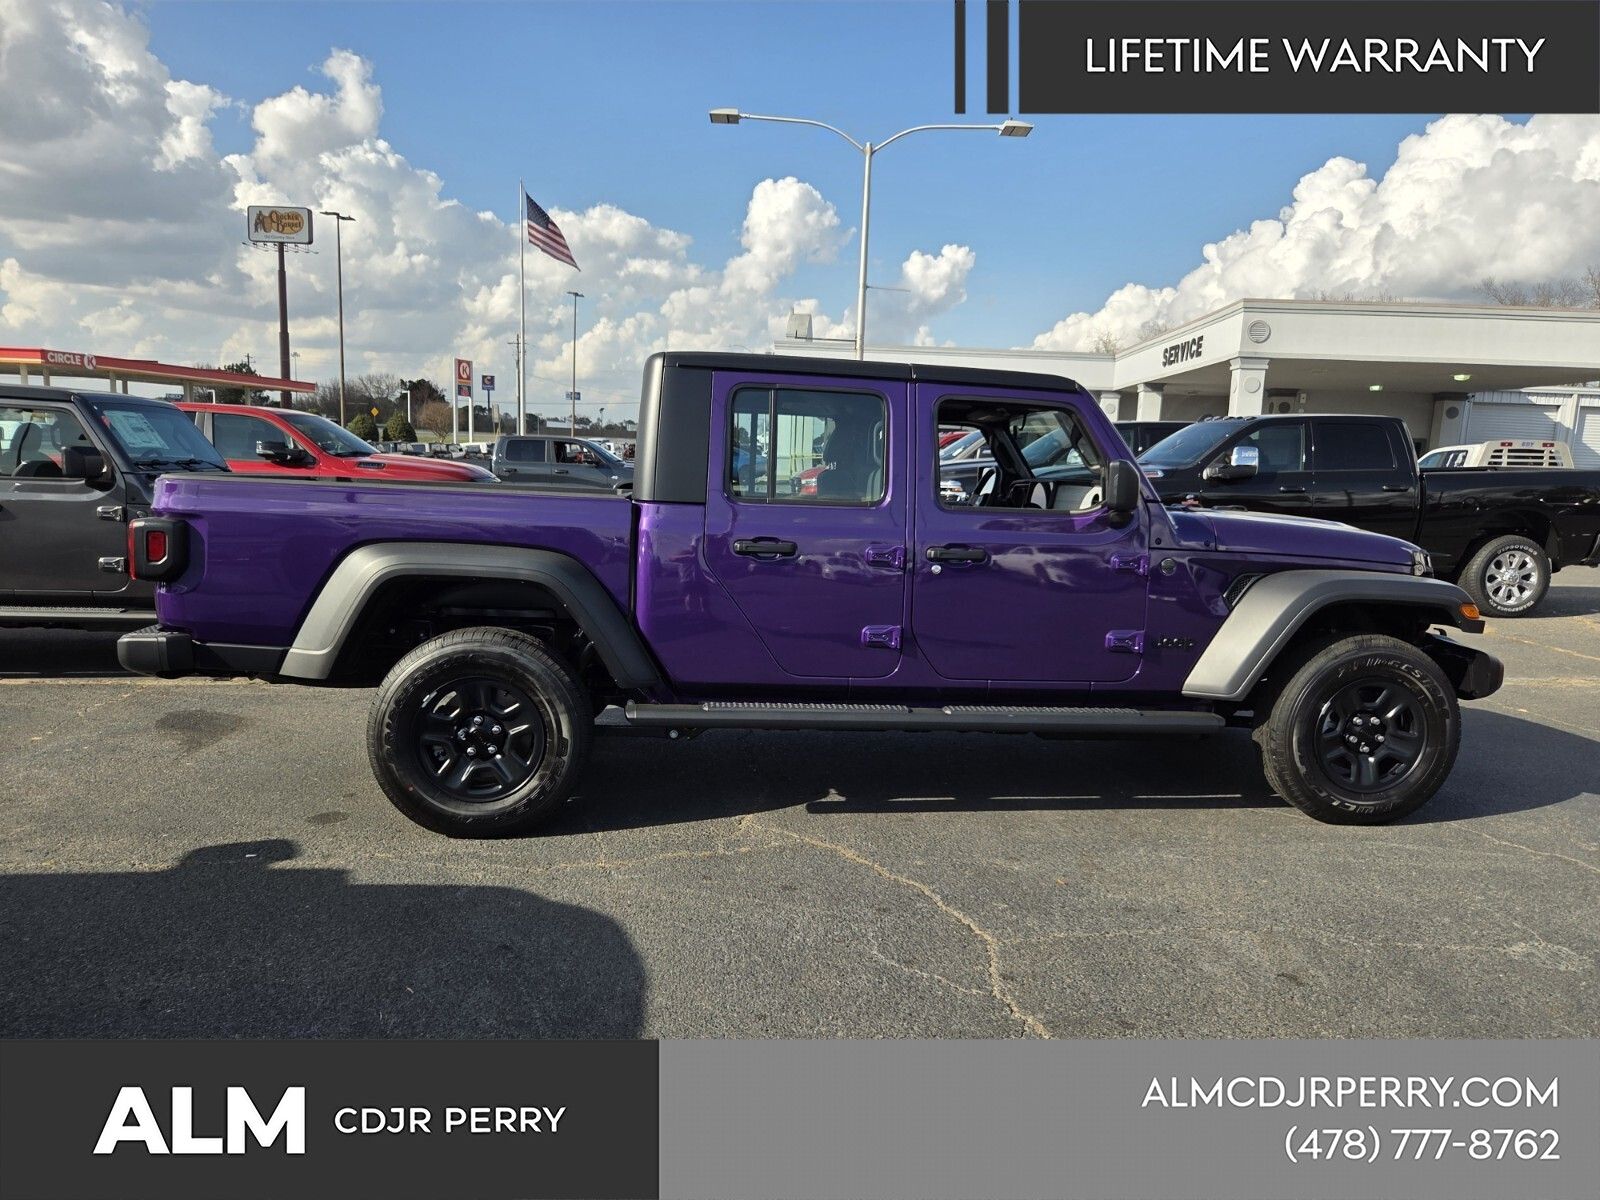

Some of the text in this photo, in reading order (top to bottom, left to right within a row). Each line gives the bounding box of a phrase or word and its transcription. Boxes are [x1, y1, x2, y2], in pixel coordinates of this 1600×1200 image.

[47, 352, 96, 370] CIRCLE K
[1162, 335, 1204, 368] SERVICE
